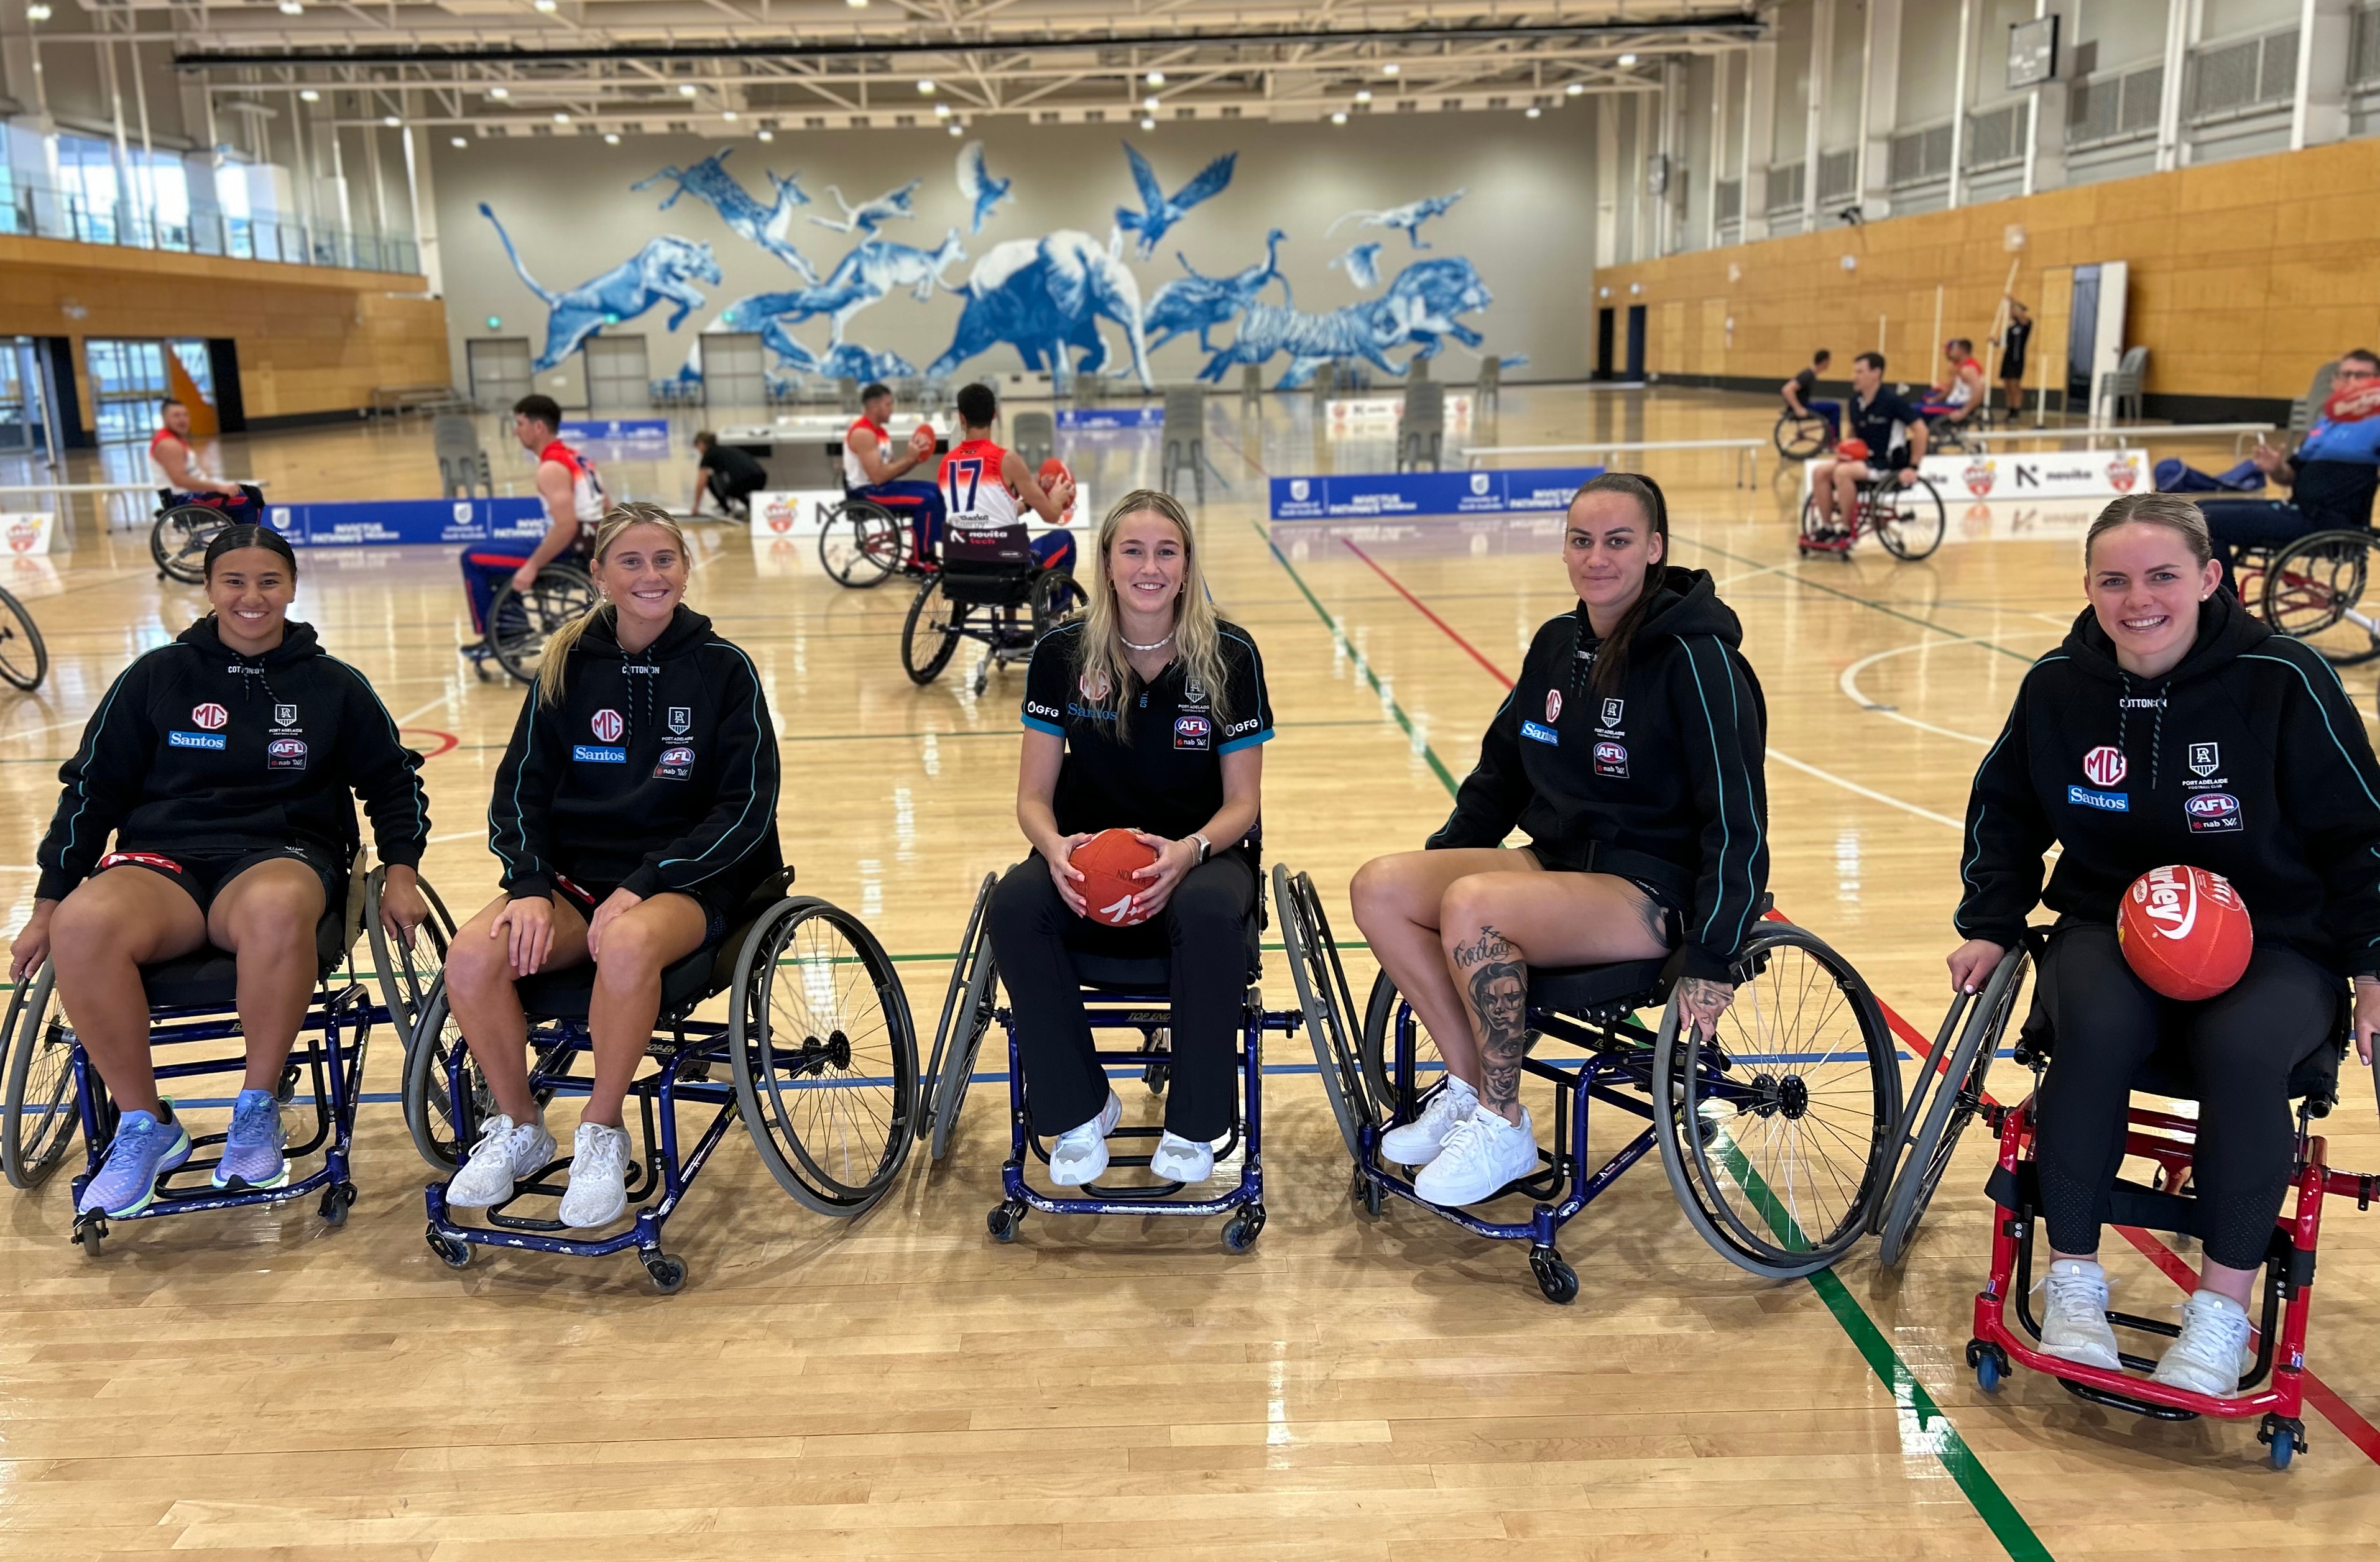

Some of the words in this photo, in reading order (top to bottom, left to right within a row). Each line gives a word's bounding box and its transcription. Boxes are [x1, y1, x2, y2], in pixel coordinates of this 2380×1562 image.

[948, 457, 984, 513] 17
[195, 705, 226, 727] MG
[1036, 705, 1059, 717] GFG
[593, 711, 620, 740] MG
[1179, 721, 1207, 731] AFL
[1235, 719, 1258, 732] GFG
[171, 733, 224, 748] Santos
[272, 743, 303, 753] AFL
[575, 747, 624, 761] Santos
[1597, 747, 1623, 760] AFL
[663, 751, 691, 762] AFL
[2087, 749, 2123, 783] MG
[2071, 788, 2126, 809] Santos
[2192, 799, 2235, 812] AFL
[2203, 819, 2220, 827] nab
[1117, 869, 1146, 886] NOVTA
[2146, 865, 2187, 923] urley
[662, 1045, 676, 1054] EN
